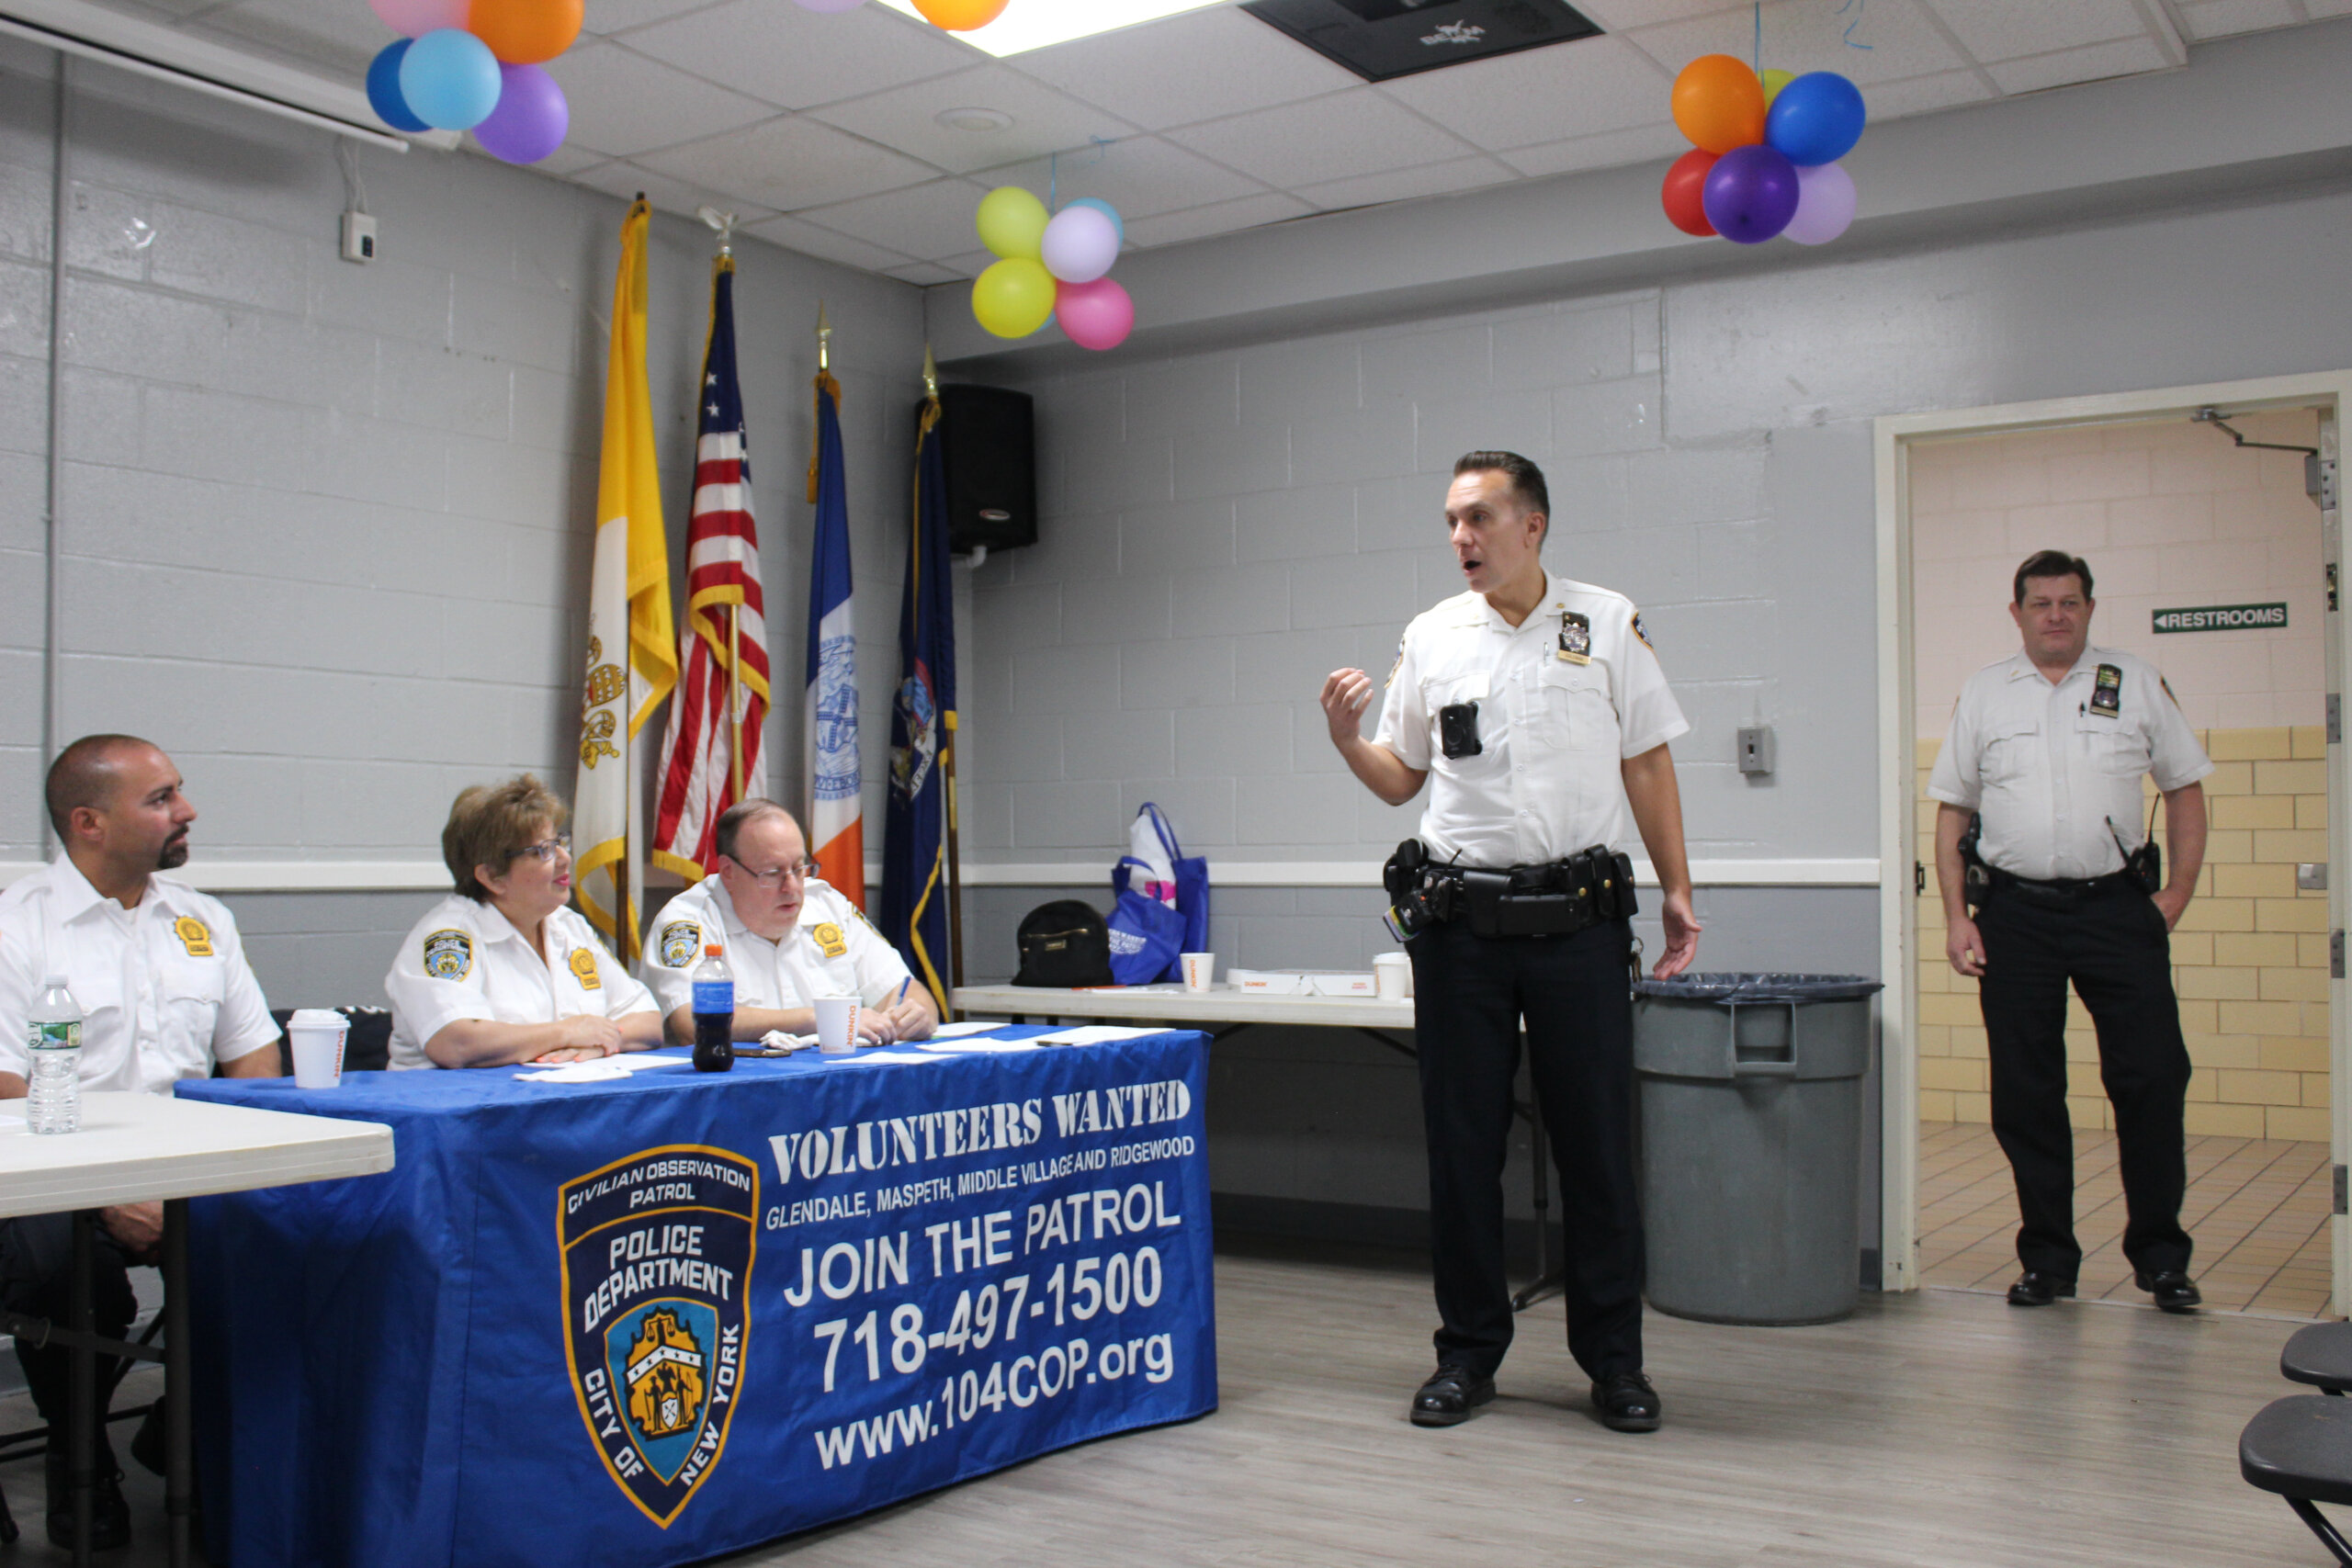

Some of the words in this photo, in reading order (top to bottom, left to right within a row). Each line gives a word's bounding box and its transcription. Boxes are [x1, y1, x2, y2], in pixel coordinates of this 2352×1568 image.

[2168, 608, 2284, 628] RESTROOMS
[768, 1098, 1042, 1185] VOLUNTEERS
[1052, 1078, 1191, 1138] WANTED
[568, 1167, 644, 1215] CIVILIAN
[646, 1159, 751, 1192] OBSERVATION
[629, 1182, 695, 1209] PATROL
[766, 1191, 871, 1231] GLENDALE,
[876, 1176, 954, 1213] MASPETH,
[957, 1166, 1017, 1196] MIDDLE
[1021, 1154, 1073, 1185] VILLAGE
[1074, 1149, 1106, 1172] AND
[1111, 1135, 1194, 1168] RIDGEWOOD
[610, 1224, 705, 1270] POLICE
[784, 1231, 909, 1308] JOIN
[925, 1211, 1012, 1278] THE
[1024, 1180, 1182, 1255] PATROL
[584, 1258, 733, 1334] DEPARTMENT
[813, 1246, 1162, 1393] 718-497-1500
[584, 1368, 621, 1438] CITY
[614, 1446, 644, 1478] OF
[680, 1421, 719, 1486] NEW
[712, 1324, 740, 1404] YORK
